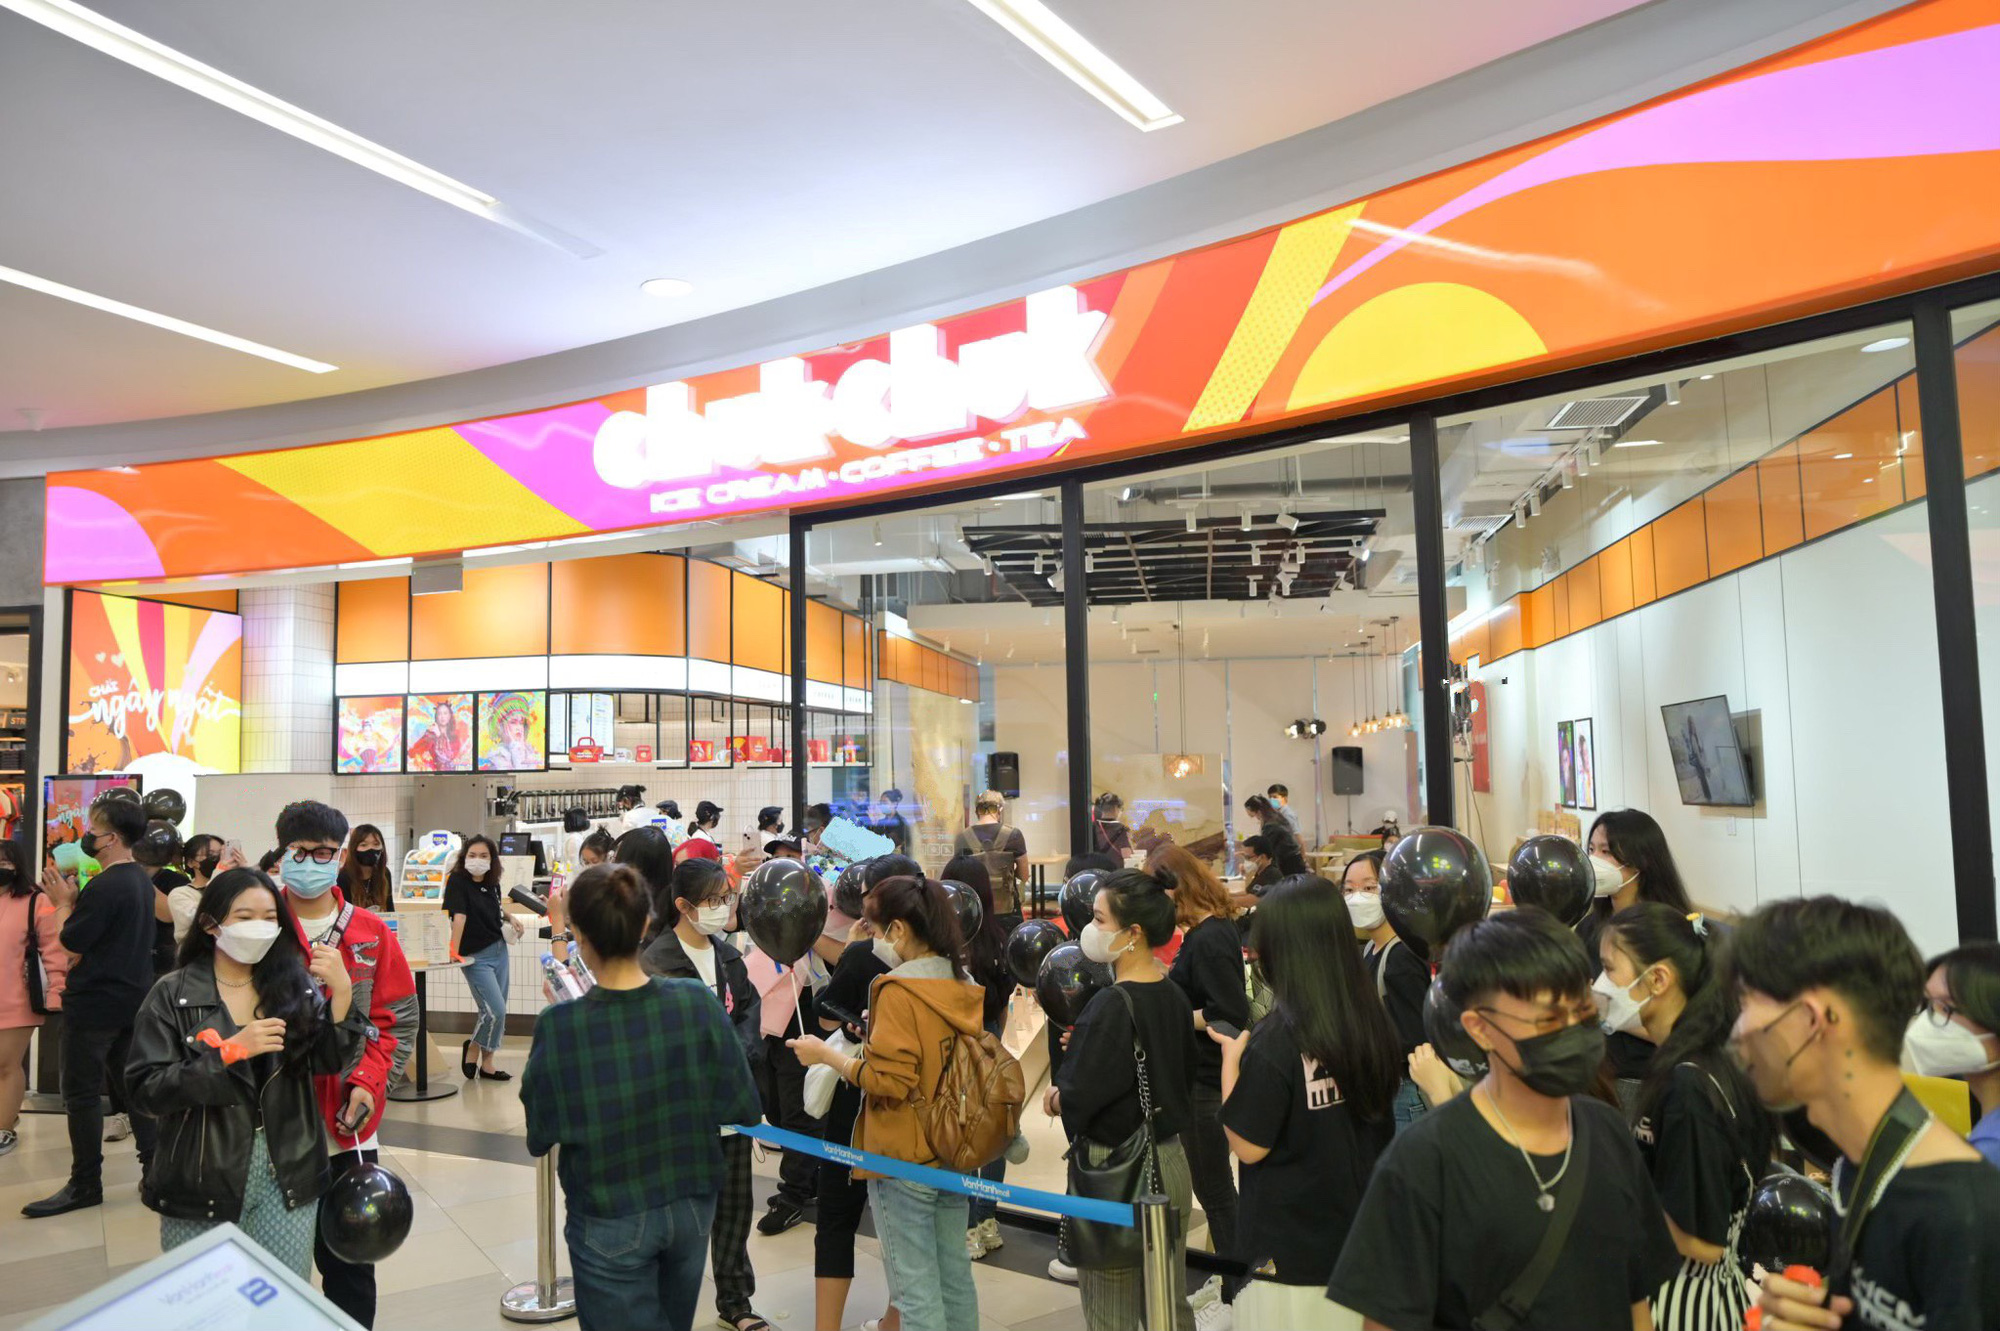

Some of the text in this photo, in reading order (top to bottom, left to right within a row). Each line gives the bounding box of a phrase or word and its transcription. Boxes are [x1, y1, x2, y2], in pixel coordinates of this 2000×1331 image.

[650, 417, 1088, 513] ICE CREAM COFFEE TEA
